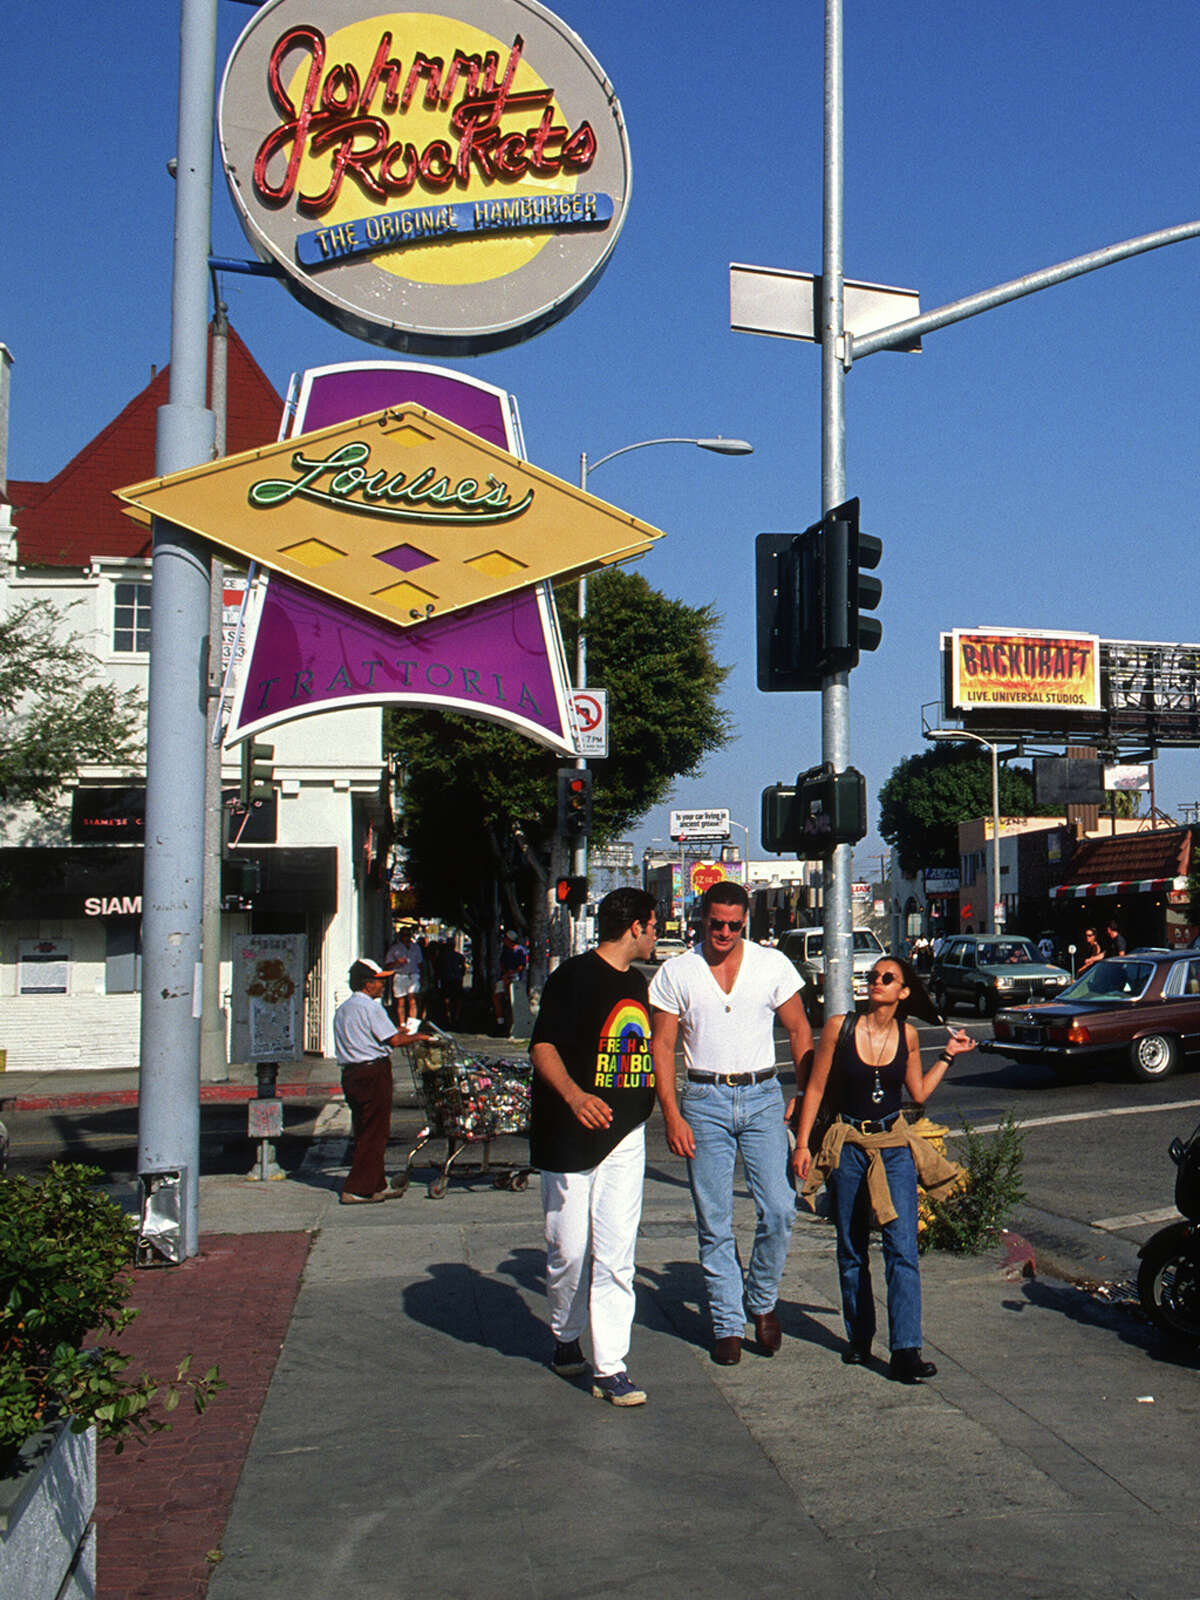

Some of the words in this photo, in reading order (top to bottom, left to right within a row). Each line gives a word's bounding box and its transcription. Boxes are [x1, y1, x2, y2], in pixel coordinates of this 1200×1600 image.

[254, 24, 555, 211] Johnny
[298, 106, 598, 219] Rockets
[315, 223, 357, 254] THE
[366, 205, 459, 241] ORIGINAL
[474, 193, 598, 223] HAMBURGER
[248, 441, 535, 524] Louise's
[962, 643, 1091, 679] BACKDRAFT
[257, 660, 543, 716] TRATTORIA
[967, 691, 991, 702] LIVE.
[992, 692, 1044, 703] UNIVERSAL
[1046, 693, 1087, 705] STUDIOS.
[597, 1053, 655, 1073] RAINBO
[598, 1038, 636, 1053] FRESH
[595, 1072, 656, 1088] REVOLUTIO
